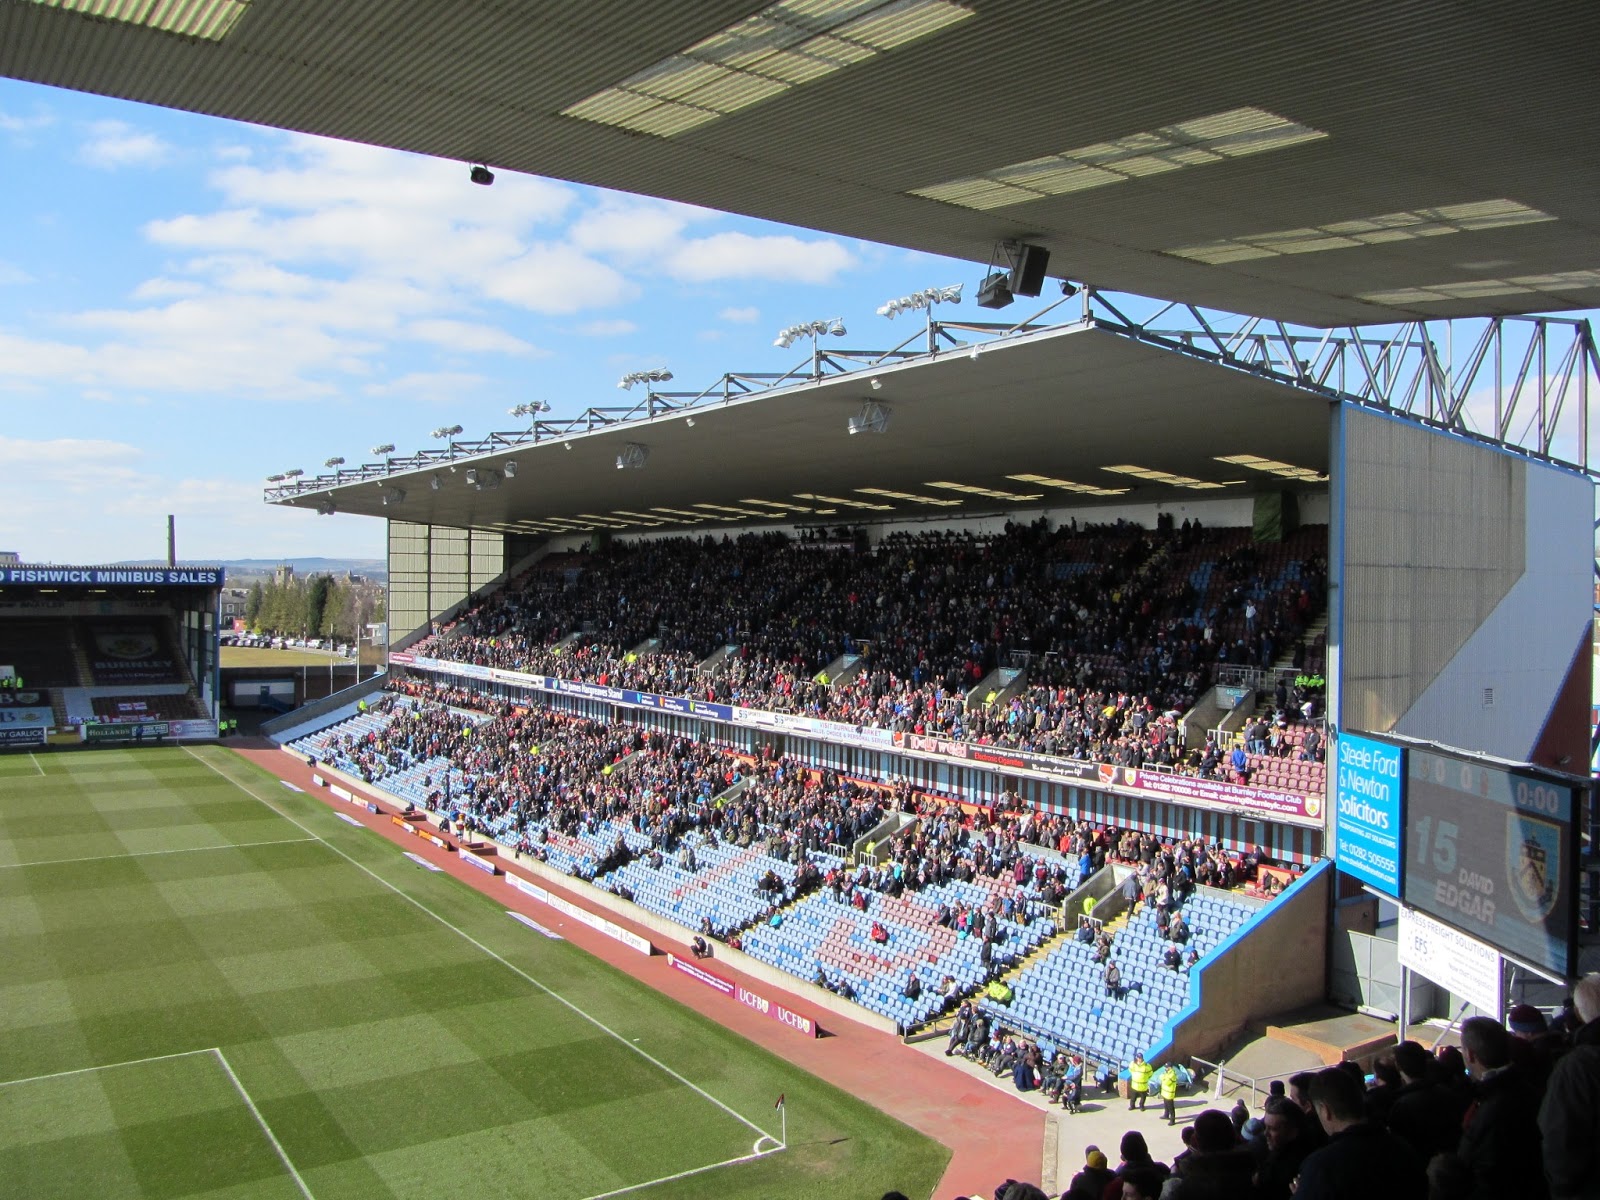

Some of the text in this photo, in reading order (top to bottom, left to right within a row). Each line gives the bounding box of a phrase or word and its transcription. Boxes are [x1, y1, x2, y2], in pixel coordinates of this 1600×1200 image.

[11, 571, 91, 582] FISHWICK
[97, 571, 164, 583] MINIBUS
[169, 572, 217, 583] SALES
[608, 688, 623, 700] Stand
[9, 729, 43, 738] GARLICK
[834, 724, 858, 733] BURNLE
[860, 728, 881, 736] ARKET
[872, 737, 891, 745] SERVICE
[1340, 742, 1398, 778] Steele Ford
[1140, 772, 1159, 782] Private
[1160, 775, 1196, 787] Celebrations
[1197, 781, 1223, 792] available
[1232, 787, 1257, 798] Burnley
[1257, 791, 1284, 801] Football
[1285, 795, 1302, 804] Club
[1153, 782, 1170, 791] 01282
[1340, 766, 1389, 802] & Newton
[1435, 759, 1559, 814] 0 0 0:00
[1339, 791, 1389, 829] Solicitors
[1349, 843, 1367, 860] 01282
[1368, 851, 1396, 873] 505555
[1415, 815, 1459, 874] 15
[1459, 868, 1494, 895] DAVID
[1435, 879, 1496, 925] EDGAR
[1401, 908, 1427, 929] EXPRESS
[1428, 921, 1454, 941] FREIGHT
[1455, 935, 1495, 963] SOLUTIONS
[1415, 936, 1428, 955] EFS
[740, 988, 763, 1011] UCFB
[778, 1006, 803, 1030] UCFB
